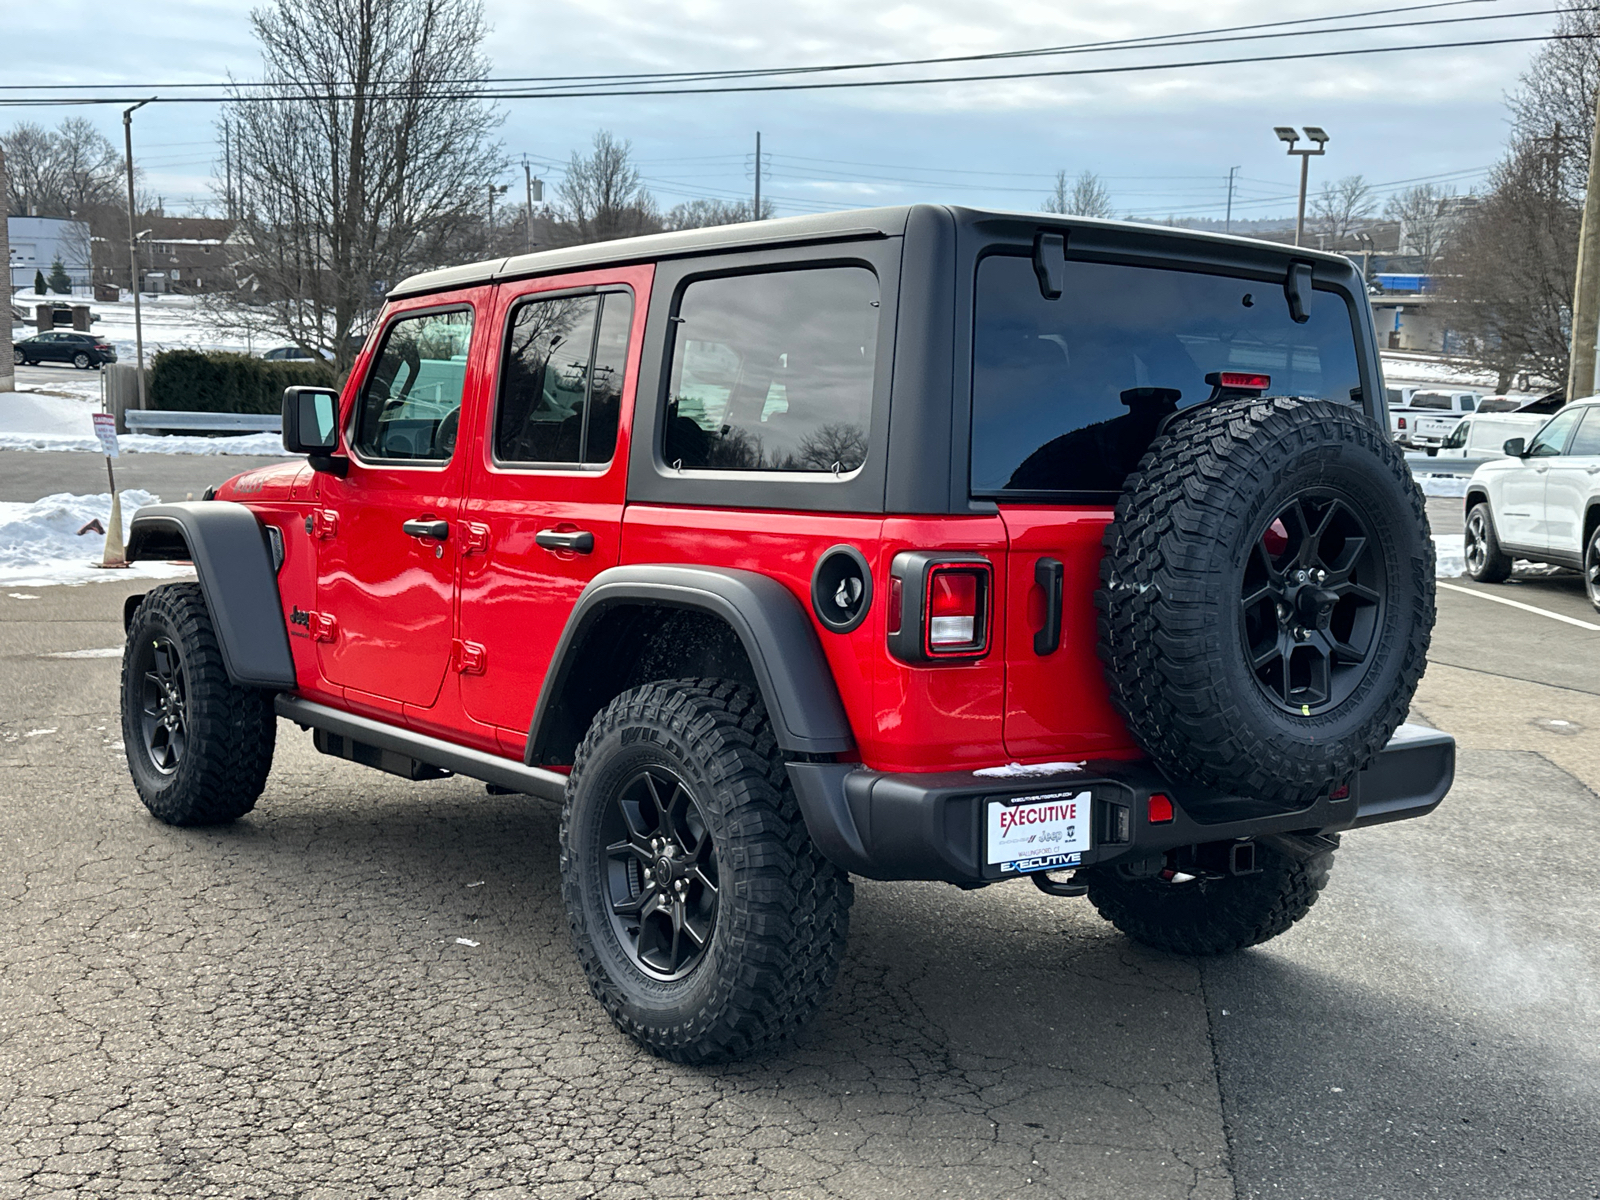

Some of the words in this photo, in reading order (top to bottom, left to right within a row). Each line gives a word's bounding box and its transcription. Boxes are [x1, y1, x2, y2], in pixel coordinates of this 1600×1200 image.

[1000, 804, 1077, 837] EXECUTIVE
[1038, 830, 1063, 843] Jeep
[1000, 853, 1081, 872] EXECUTIVE
